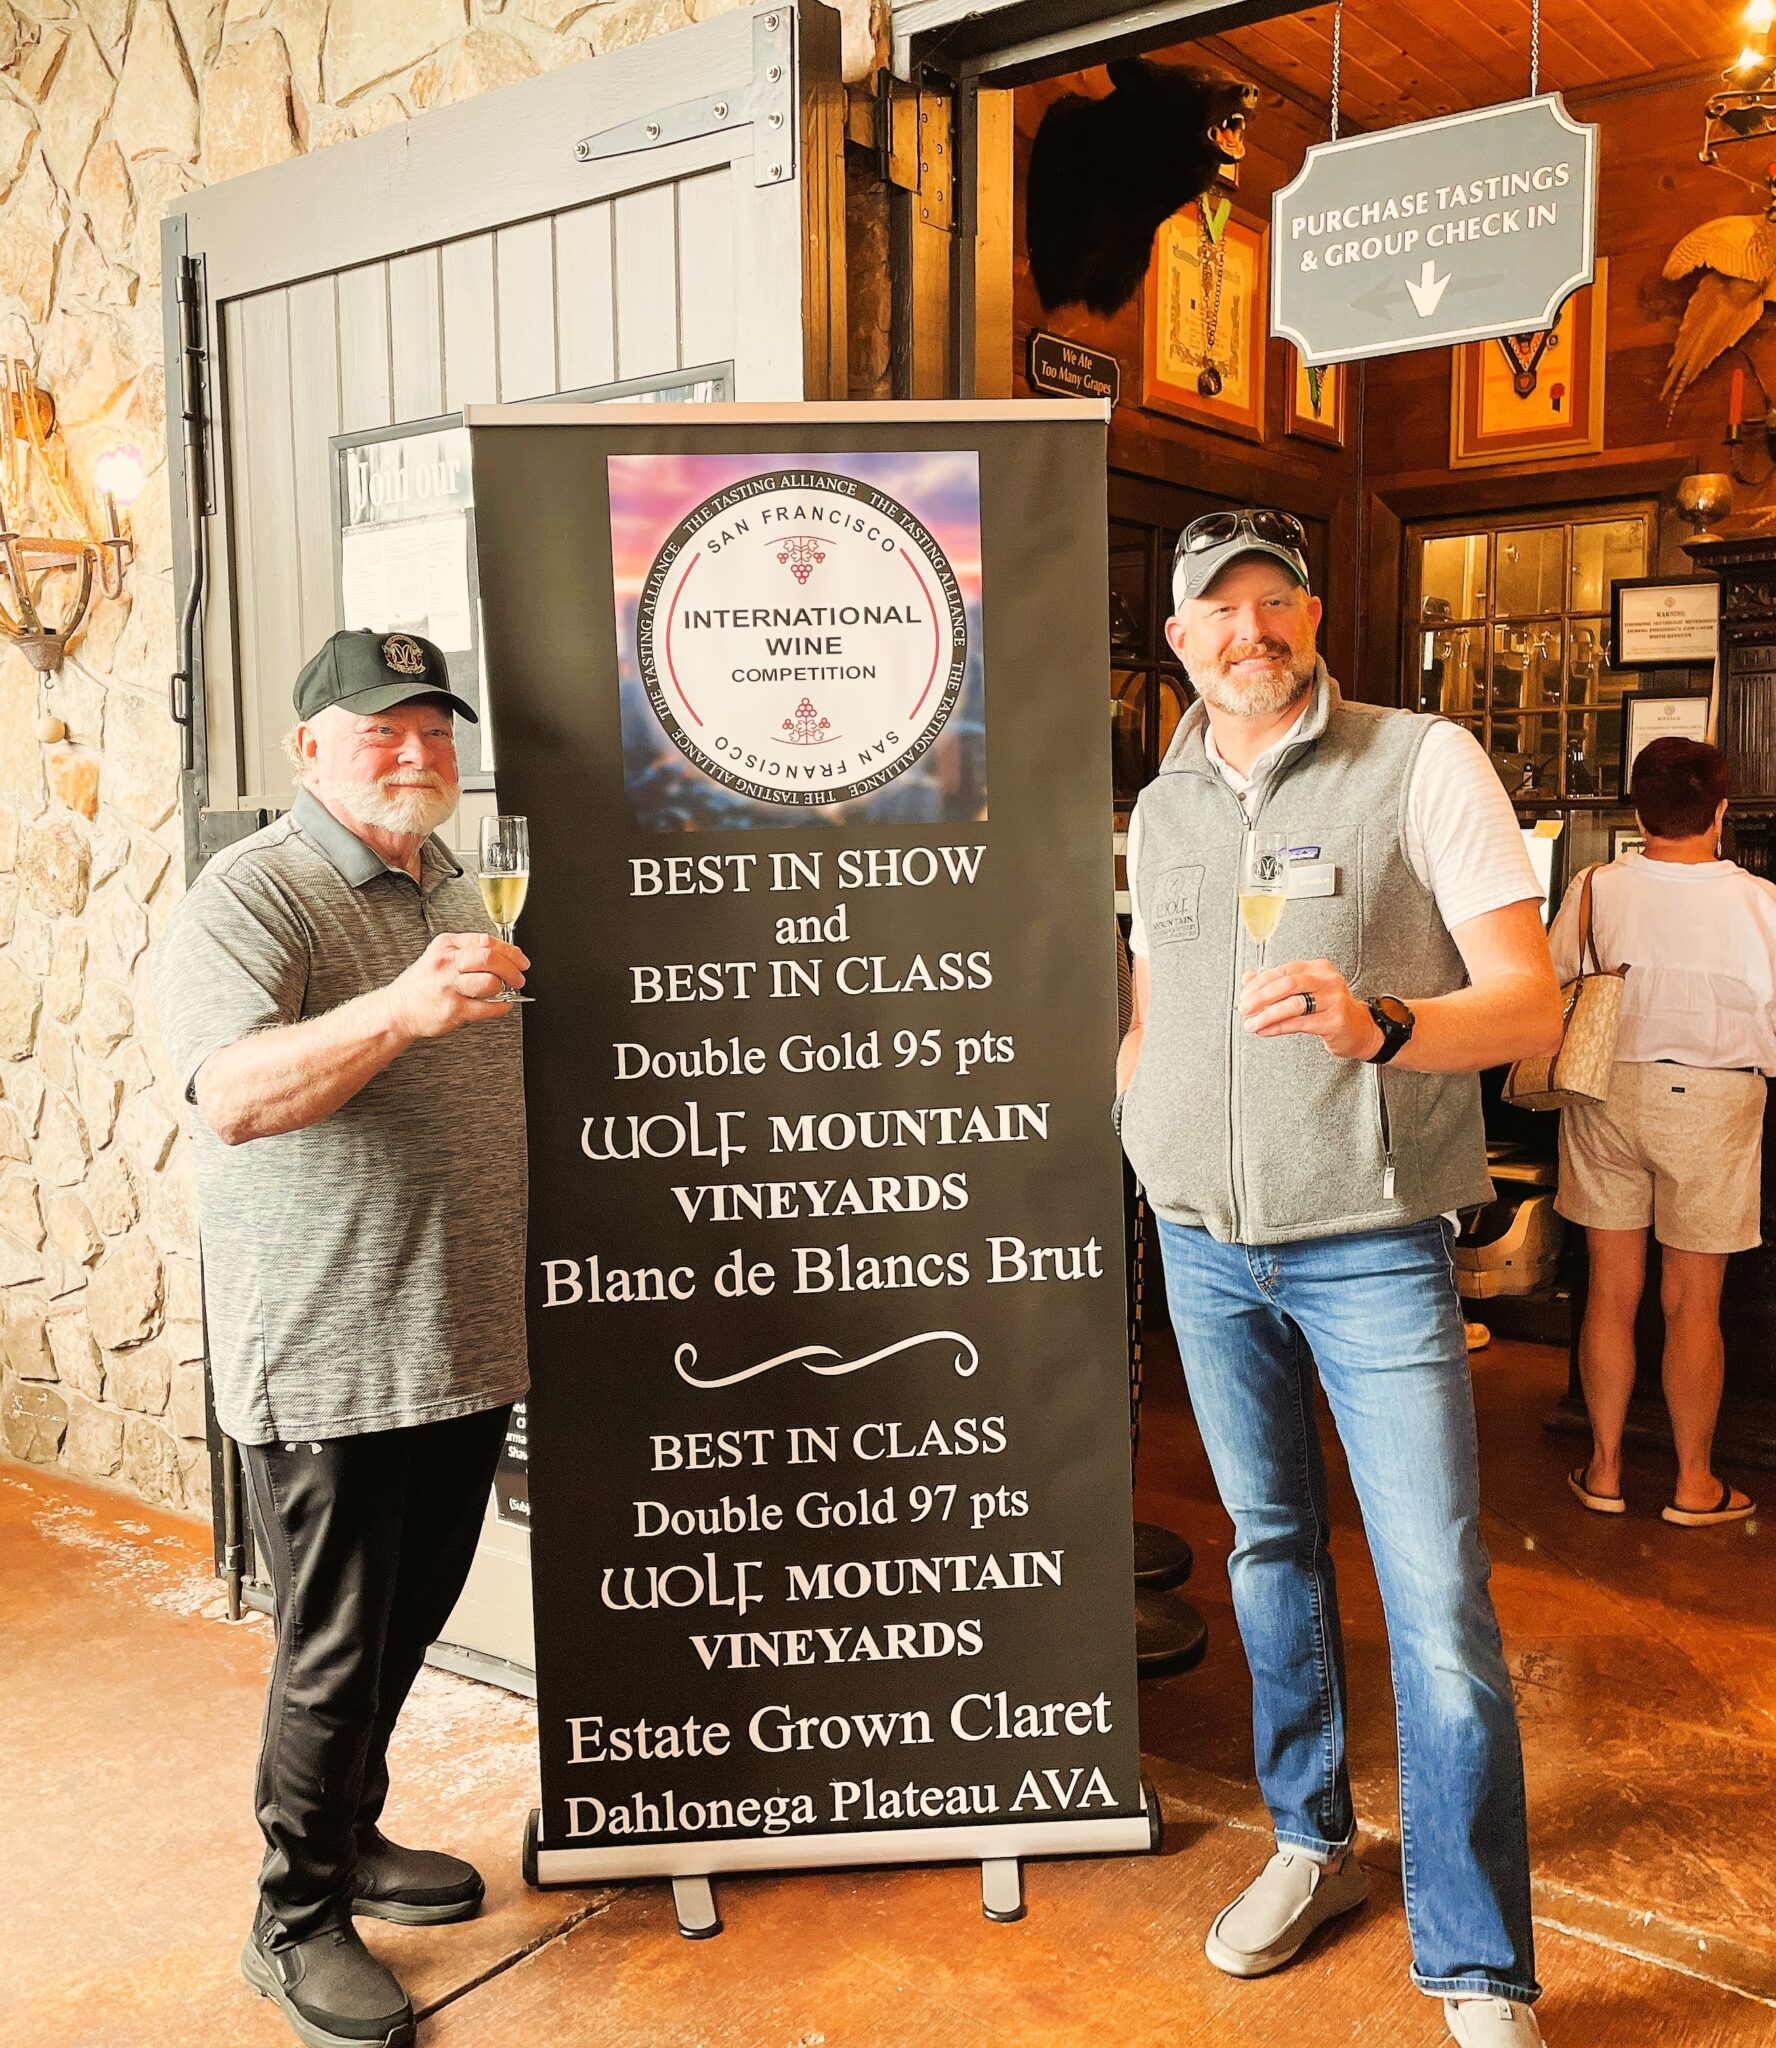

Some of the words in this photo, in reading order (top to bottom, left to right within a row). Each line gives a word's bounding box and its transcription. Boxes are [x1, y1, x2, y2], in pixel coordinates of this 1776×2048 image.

[1291, 191, 1430, 240] PURCHASE
[1435, 162, 1570, 210] TASTINGS
[1300, 249, 1318, 273] &
[1324, 229, 1419, 267] GROUP
[1426, 208, 1521, 248] CHECK
[1527, 202, 1557, 229] IN
[1041, 360, 1057, 378] Too
[1058, 366, 1082, 389] Many
[1083, 374, 1111, 395] Grapes
[1062, 347, 1077, 365] We
[682, 506, 713, 535] THE
[711, 477, 776, 512] TASTING
[780, 474, 858, 497] ALLIANCE
[707, 519, 750, 554] SAN
[761, 505, 895, 552] FRANCISCO
[644, 541, 681, 617] ALLIANCE
[869, 492, 899, 518] THE
[899, 513, 946, 570] TASTING
[939, 571, 966, 647] ALLIANCE
[684, 606, 922, 629] INTERNATIONAL
[640, 619, 658, 687] TASTING
[765, 637, 843, 656] WINE
[731, 666, 876, 682] COMPETITION
[947, 661, 965, 692] THE
[650, 688, 671, 721] THE
[914, 696, 955, 753] TASTING
[671, 728, 733, 784] ALLIANCE
[715, 737, 847, 779] FRANCISCO
[848, 750, 917, 797] ALLIANCE
[858, 731, 899, 765] SAN
[735, 782, 799, 804] TASTING
[804, 790, 836, 805] THE
[628, 854, 757, 896] BEST
[767, 851, 824, 891] IN
[837, 845, 987, 889] SHOW
[775, 903, 851, 945] and
[628, 961, 757, 1004] BEST
[768, 959, 823, 998] IN
[836, 950, 993, 995] CLASS
[612, 1036, 766, 1080] Double
[779, 1030, 883, 1073] Gold
[893, 1029, 942, 1068] 95
[954, 1030, 1015, 1076] pts
[767, 1102, 1051, 1153] MOUNTAIN
[670, 1172, 969, 1223] VINEYARDS
[540, 1254, 696, 1308] Blanc
[714, 1248, 776, 1298] de
[791, 1243, 970, 1294] Blancs
[985, 1236, 1104, 1284] Brut
[649, 1429, 775, 1471] BEST
[786, 1426, 840, 1464] IN
[852, 1415, 1007, 1460] CLASS
[632, 1493, 783, 1537] Double
[796, 1486, 898, 1529] Gold
[909, 1484, 957, 1523] 97
[969, 1484, 1029, 1530] pts
[784, 1549, 1065, 1601] MOUNTAIN
[688, 1618, 984, 1671] VINEYARDS
[565, 1715, 731, 1764] Estate
[748, 1704, 935, 1753] Grown
[950, 1690, 1113, 1741] Claret
[564, 1789, 818, 1838] Dahlonega
[828, 1779, 1000, 1822] Plateau
[1008, 1766, 1119, 1812] AVA
